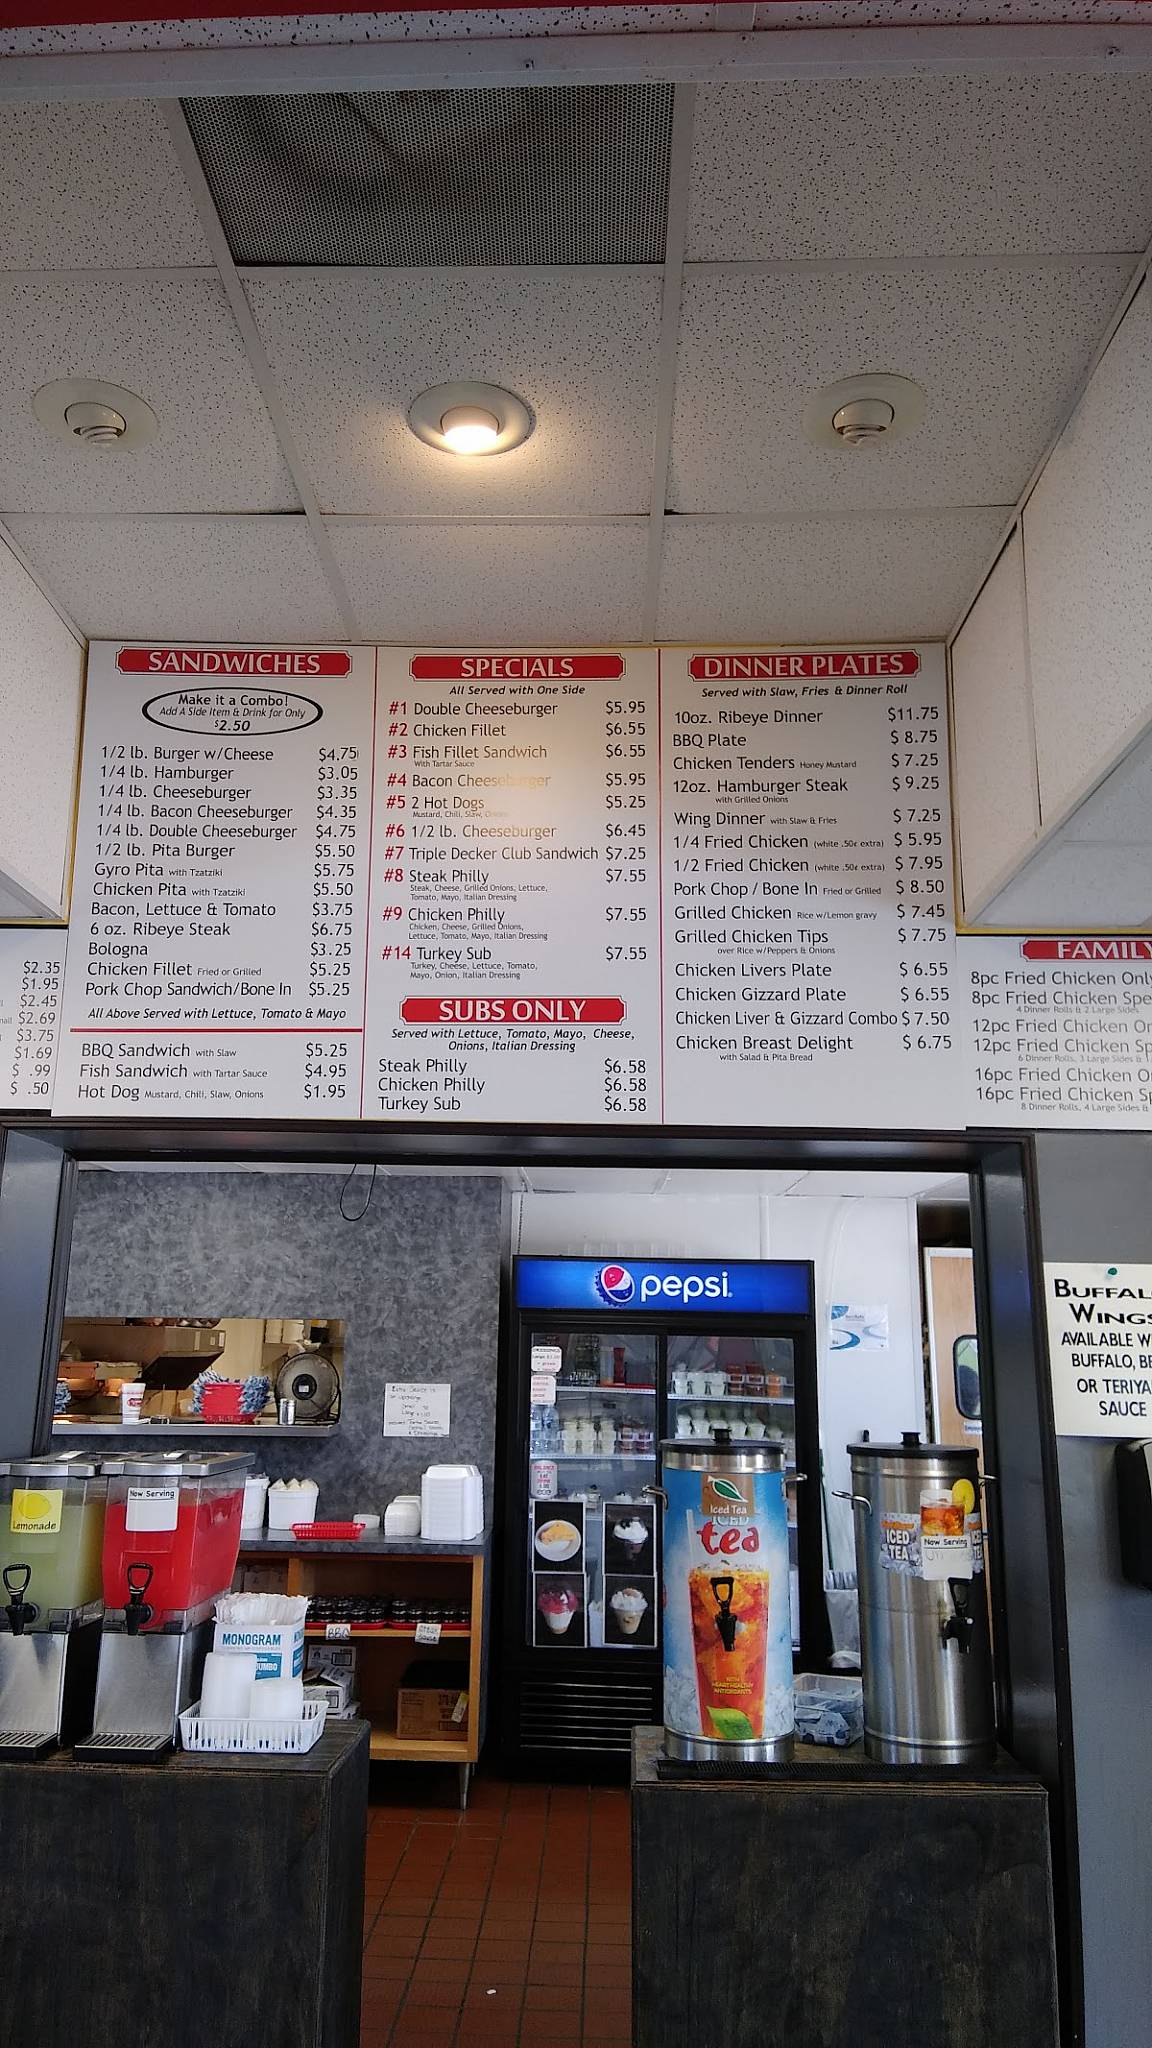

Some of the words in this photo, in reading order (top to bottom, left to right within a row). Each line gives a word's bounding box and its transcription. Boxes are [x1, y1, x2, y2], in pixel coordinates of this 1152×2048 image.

[148, 651, 321, 674] SANDWICHES
[460, 658, 574, 677] SPECIALS
[704, 656, 810, 677] DINNER
[812, 654, 904, 676] PLATES
[449, 686, 464, 694] All
[468, 686, 505, 694] Served
[509, 685, 533, 694] with
[537, 686, 558, 694] One
[562, 685, 585, 694] Side
[702, 688, 739, 697] Served
[742, 687, 766, 696] with
[770, 687, 797, 698] Slaw,
[802, 686, 829, 695] Fries
[835, 686, 842, 695] &
[846, 685, 883, 694] Dinner
[886, 684, 907, 694] Roll
[178, 694, 211, 706] Make
[216, 694, 225, 705] it
[229, 697, 235, 705] a
[240, 694, 289, 707] Combo!
[389, 701, 406, 715] #1
[415, 702, 460, 715] Double
[465, 702, 558, 717] Cheeseburger
[606, 700, 645, 715] $5.95
[159, 706, 178, 715] Add
[179, 707, 185, 715] A
[187, 706, 207, 716] Side
[210, 707, 230, 716] Item
[233, 708, 239, 716] &
[243, 708, 266, 717] Drink
[268, 708, 283, 718] for
[285, 708, 306, 719] Only
[675, 711, 712, 724] 10oz.
[719, 711, 768, 726] Ribeye
[774, 710, 823, 722] Dinner
[888, 706, 938, 722] $11.75
[215, 720, 250, 731] $2.50
[389, 723, 408, 736] #2
[414, 724, 466, 736] Chicken
[472, 724, 506, 736] Fillet
[606, 722, 645, 737] $6.55
[673, 734, 704, 748] BBQ
[708, 733, 746, 746] Plate
[101, 765, 125, 778] 1/4
[131, 765, 147, 778] lb.
[155, 766, 234, 782] Hamburger
[318, 766, 357, 782] $3.05
[99, 804, 122, 816] 1/4
[128, 804, 144, 817] lb.
[151, 805, 192, 817] Bacon
[198, 805, 293, 821] Cheeseburger
[317, 805, 356, 820] $4.35
[385, 846, 404, 860] #7
[409, 847, 446, 863] Triple
[452, 847, 497, 860] Decker
[502, 846, 531, 860] Club
[536, 846, 598, 859] Sandwich
[606, 846, 645, 861] $7.25
[94, 882, 152, 895] Chicken
[159, 883, 186, 896] Pita
[192, 888, 210, 896] with
[213, 888, 245, 896] Tzatziki
[314, 882, 353, 897] $5.50
[92, 902, 139, 918] Bacon,
[147, 902, 201, 915] Lettuce
[207, 903, 217, 915] &
[223, 903, 275, 915] Tomato
[313, 902, 352, 917] $3.75
[91, 922, 98, 935] 6
[104, 925, 126, 935] oz.
[134, 922, 184, 938] Ribeye
[190, 922, 230, 935] Steak
[312, 921, 352, 937] $6.75
[675, 930, 726, 943] Grilled
[732, 929, 792, 943] Chicken
[798, 930, 828, 945] Tips
[89, 942, 147, 958] Bologna
[311, 941, 351, 957] $3.25
[382, 946, 411, 960] #14
[416, 947, 462, 962] Turkey
[467, 947, 491, 960] Sub
[606, 946, 646, 961] $7.55
[756, 947, 798, 956] w/Peppers
[24, 960, 60, 975] $2.35
[22, 976, 58, 991] $1.95
[971, 971, 999, 988] 8pc
[1005, 971, 1045, 984] Fried
[1052, 971, 1115, 985] Chicken
[20, 994, 57, 1008] $2.45
[17, 1010, 55, 1026] $2.69
[88, 1008, 103, 1018] All
[106, 1008, 140, 1018] Above
[143, 1008, 181, 1018] Served
[184, 1008, 208, 1018] with
[212, 1008, 256, 1020] Lettuce,
[261, 1008, 302, 1018] Tomato
[305, 1008, 313, 1018] &
[317, 1008, 346, 1020] Mayo
[439, 999, 506, 1021] SUBS
[512, 999, 587, 1021] ONLY
[17, 1028, 54, 1043] $3.75
[14, 1045, 52, 1060] $1.69
[82, 1043, 114, 1059] BBQ
[119, 1043, 189, 1056] Sandwich
[306, 1042, 347, 1058] $5.25
[676, 1036, 737, 1049] Chicken
[744, 1036, 792, 1049] Breast
[798, 1036, 853, 1053] Delight
[80, 1064, 109, 1077] Fish
[116, 1064, 187, 1077] Sandwich
[214, 1069, 240, 1078] Tartar
[243, 1069, 267, 1077] Sauce
[305, 1063, 346, 1079] $4.95
[379, 1077, 438, 1091] Chicken
[444, 1077, 485, 1094] Philly
[605, 1077, 646, 1093] $6.58
[977, 1087, 1013, 1103] 16pc
[1020, 1087, 1061, 1100] Fried
[1068, 1087, 1133, 1101] Chicken
[378, 1096, 428, 1113] Turkey
[434, 1096, 460, 1110] Sub
[605, 1095, 646, 1112] $6.58
[641, 1271, 728, 1302] pepsi
[1054, 1278, 1152, 1299] BUFFAL
[1061, 1332, 1133, 1347] AVAILABLE
[1072, 1353, 1135, 1370] BUFFALO,
[1077, 1378, 1098, 1393] OR
[1099, 1401, 1147, 1416] SAUCE
[130, 1490, 143, 1498] Now
[146, 1490, 175, 1499] Serving
[710, 1504, 730, 1514] Iced
[731, 1505, 747, 1514] Tea
[13, 1521, 57, 1531] Lemonade
[696, 1520, 760, 1555] tea
[886, 1529, 910, 1545] ICED
[924, 1538, 940, 1546] Now
[943, 1538, 968, 1548] Serving
[888, 1544, 909, 1561] TEA
[222, 1633, 282, 1646] MONOGRAM
